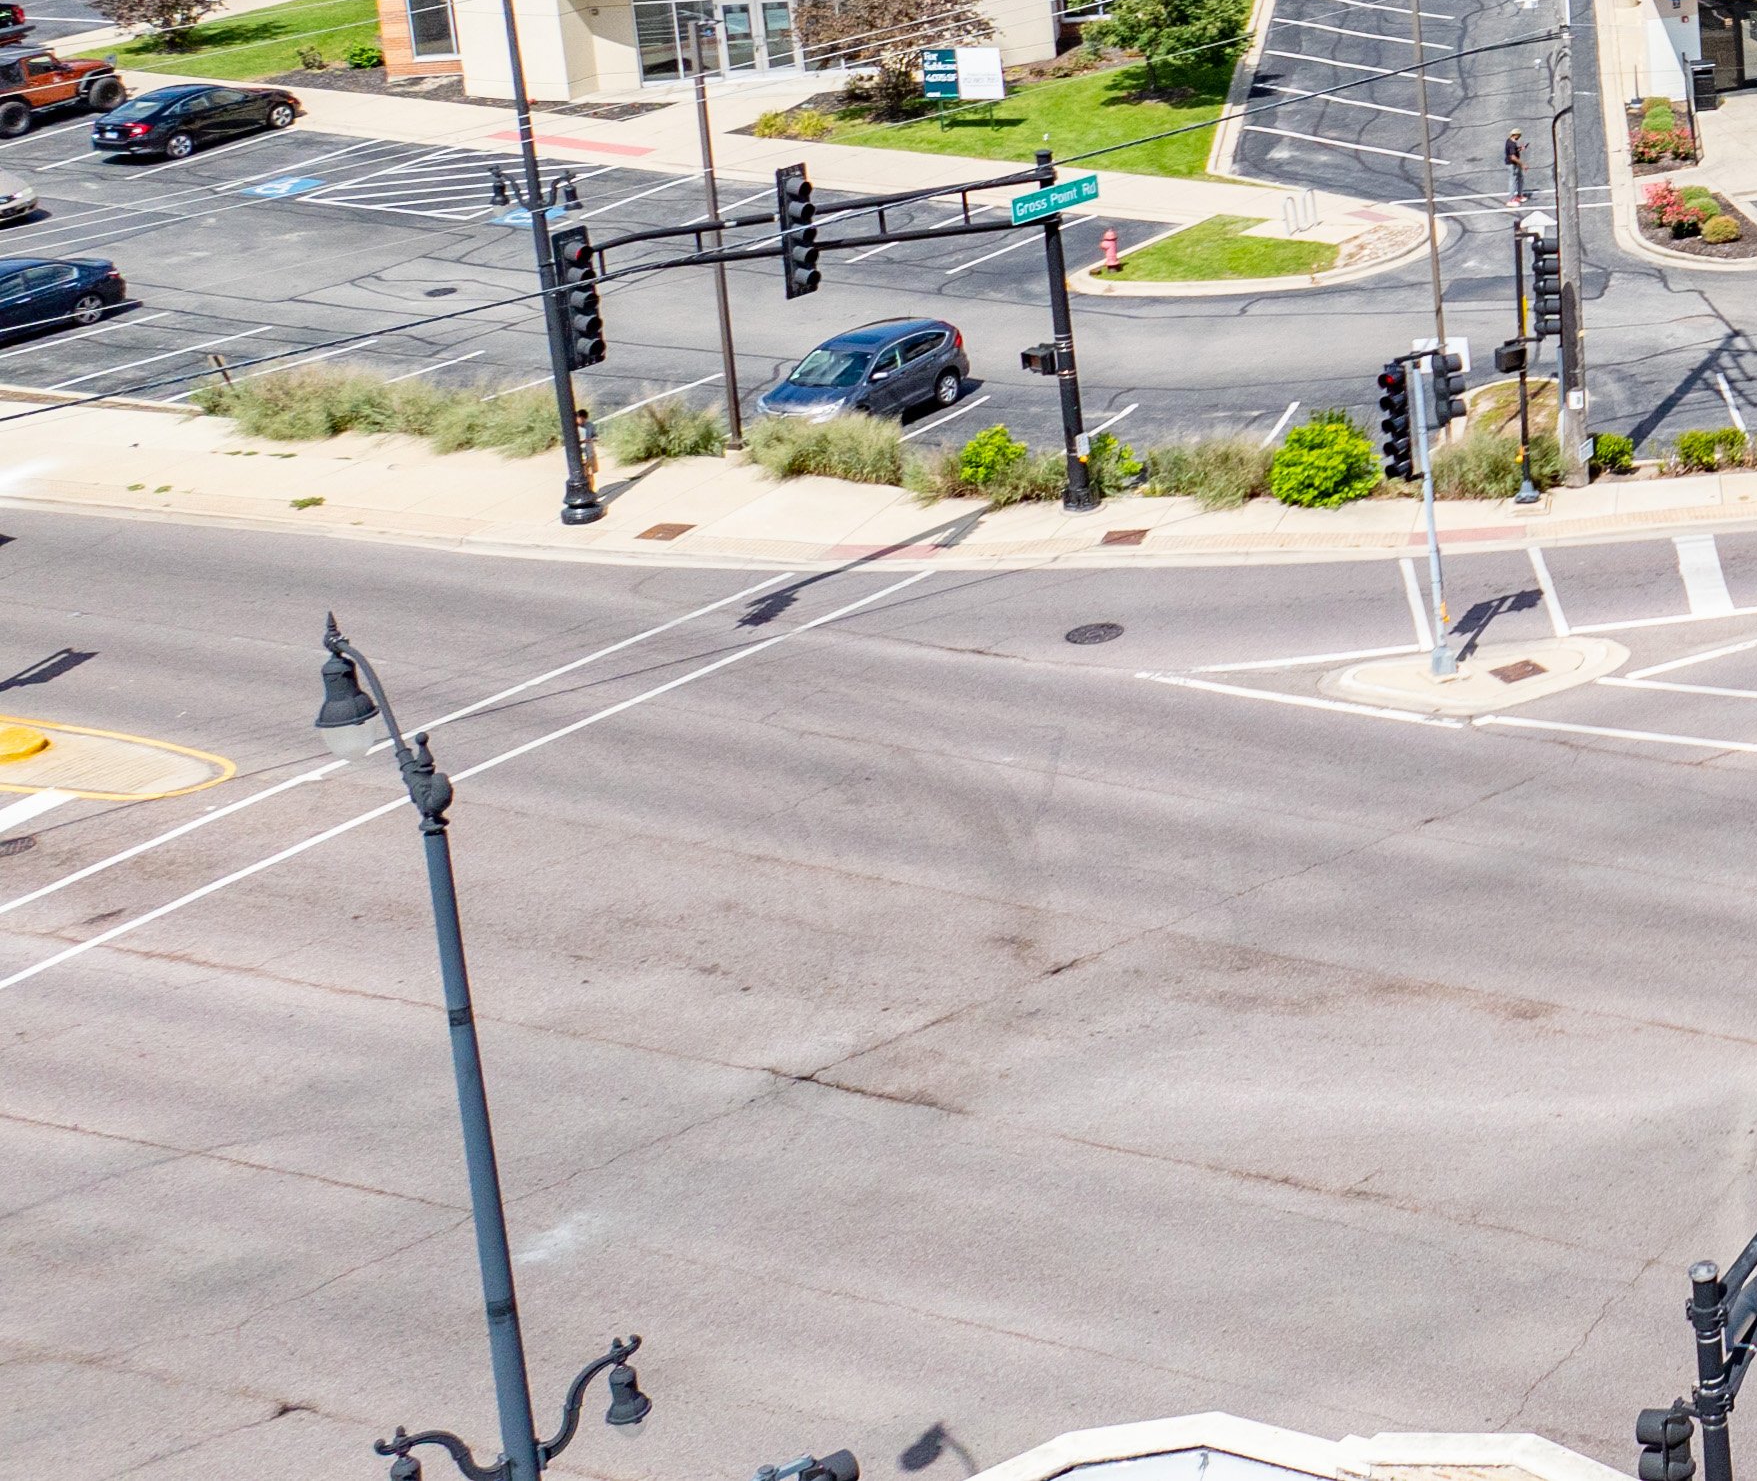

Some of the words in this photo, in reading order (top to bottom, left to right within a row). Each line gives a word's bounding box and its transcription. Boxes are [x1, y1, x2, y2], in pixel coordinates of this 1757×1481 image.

[1016, 199, 1047, 217] Gross
[1049, 187, 1077, 207] Point
[1081, 181, 1096, 195] Rd
